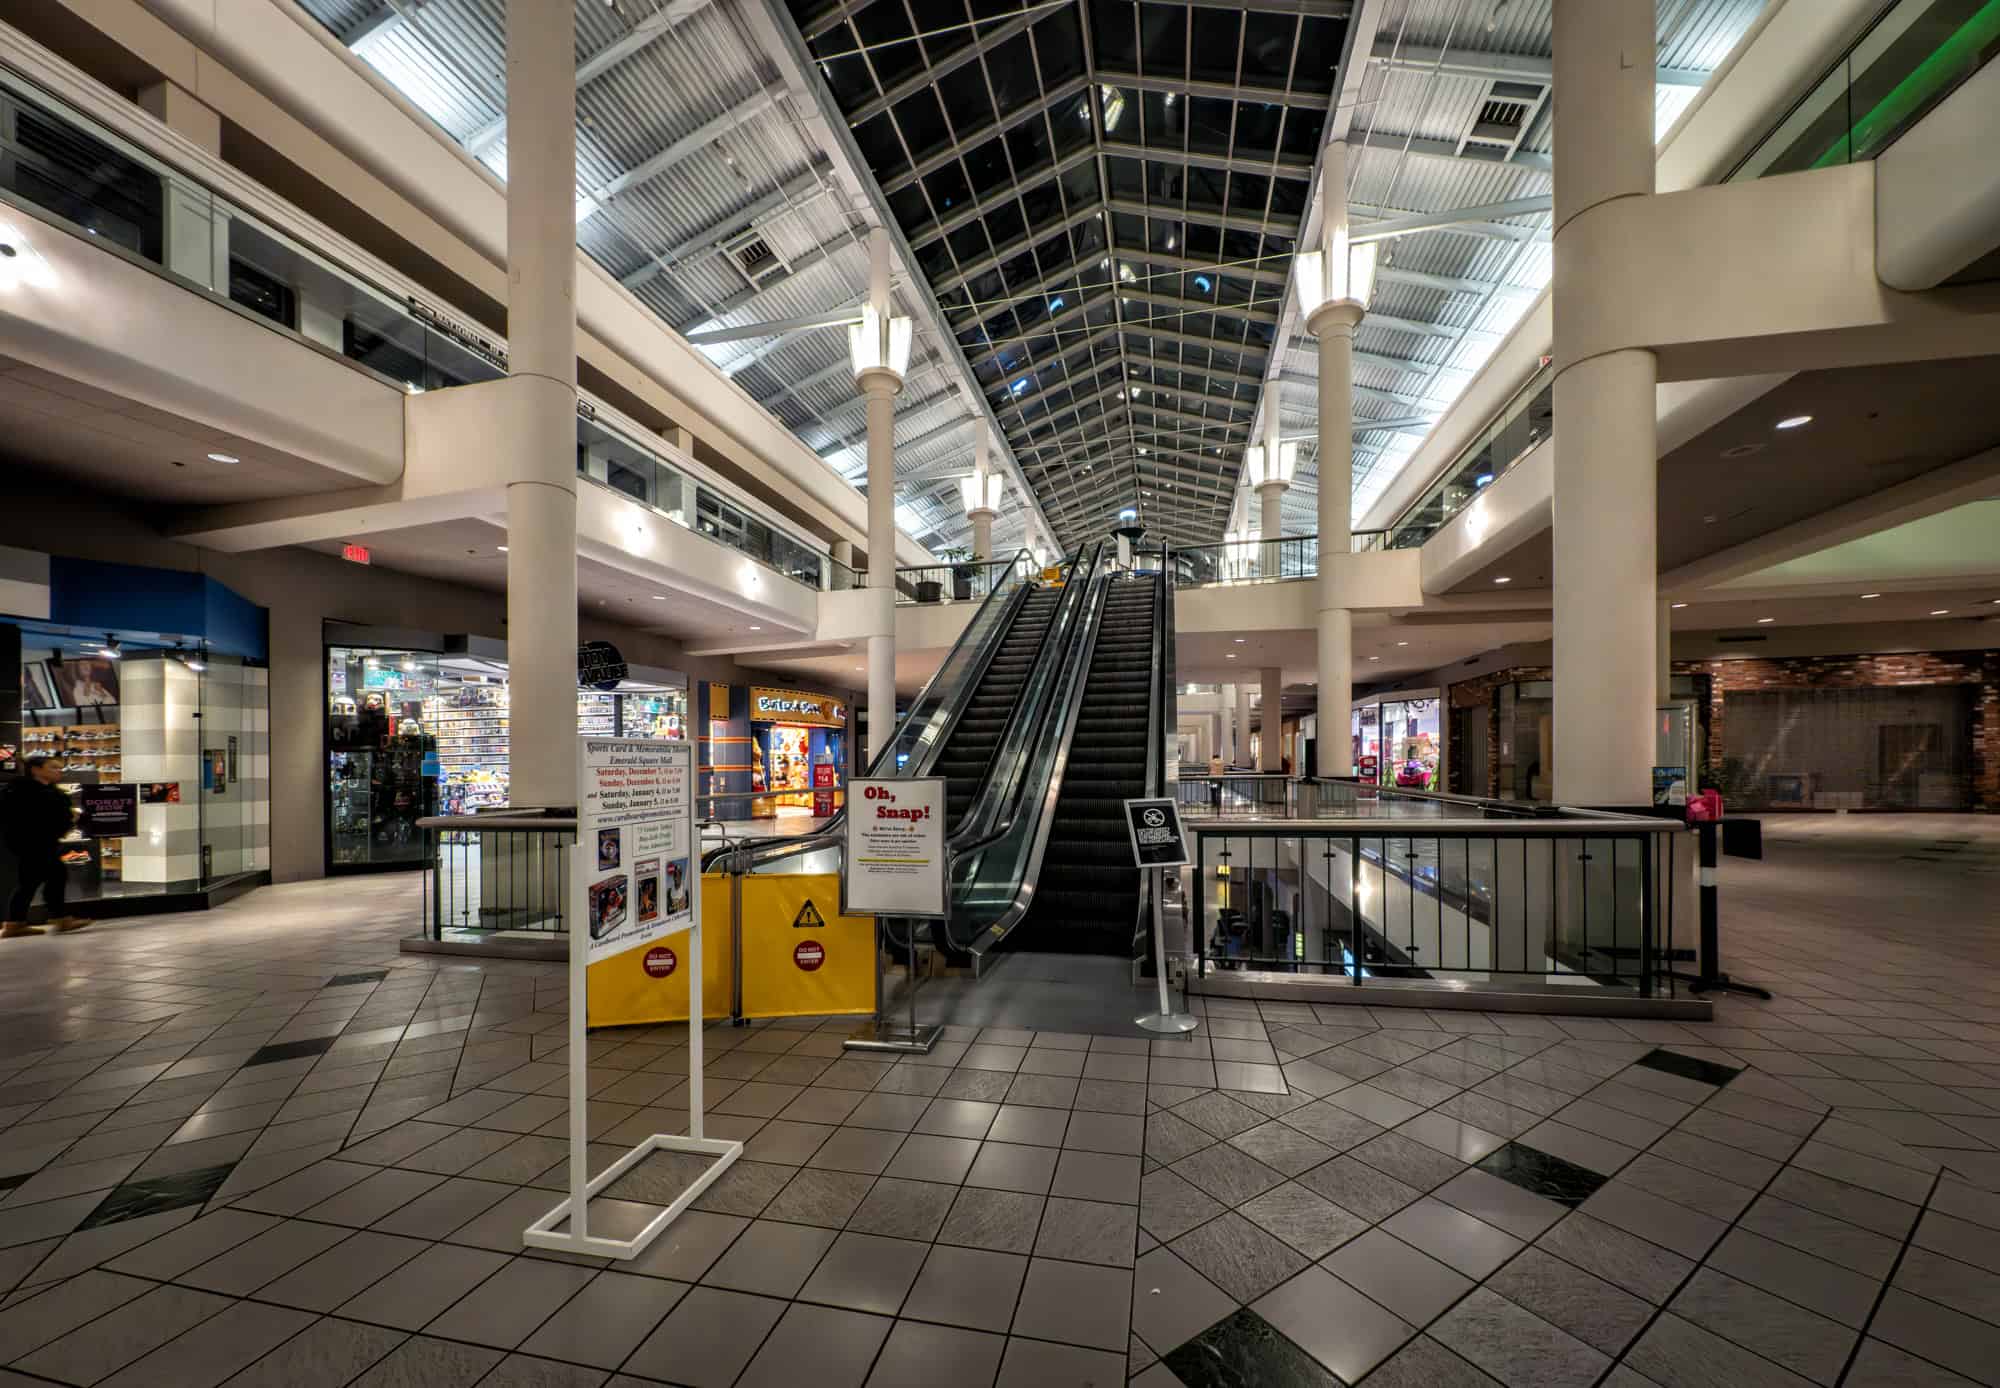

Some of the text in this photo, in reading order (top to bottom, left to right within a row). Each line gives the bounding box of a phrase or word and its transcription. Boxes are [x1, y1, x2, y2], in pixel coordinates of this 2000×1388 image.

[611, 743, 627, 753] Card
[609, 756, 637, 765] Emerald
[660, 756, 673, 764] Mall
[596, 768, 625, 777] Saturday,
[599, 779, 625, 788] Sunday,
[599, 790, 631, 799] Saturday,
[631, 788, 655, 798] January
[864, 786, 896, 802] Oh,
[602, 801, 627, 810] Sunday,
[629, 799, 653, 808] January
[876, 805, 930, 823] Snap!
